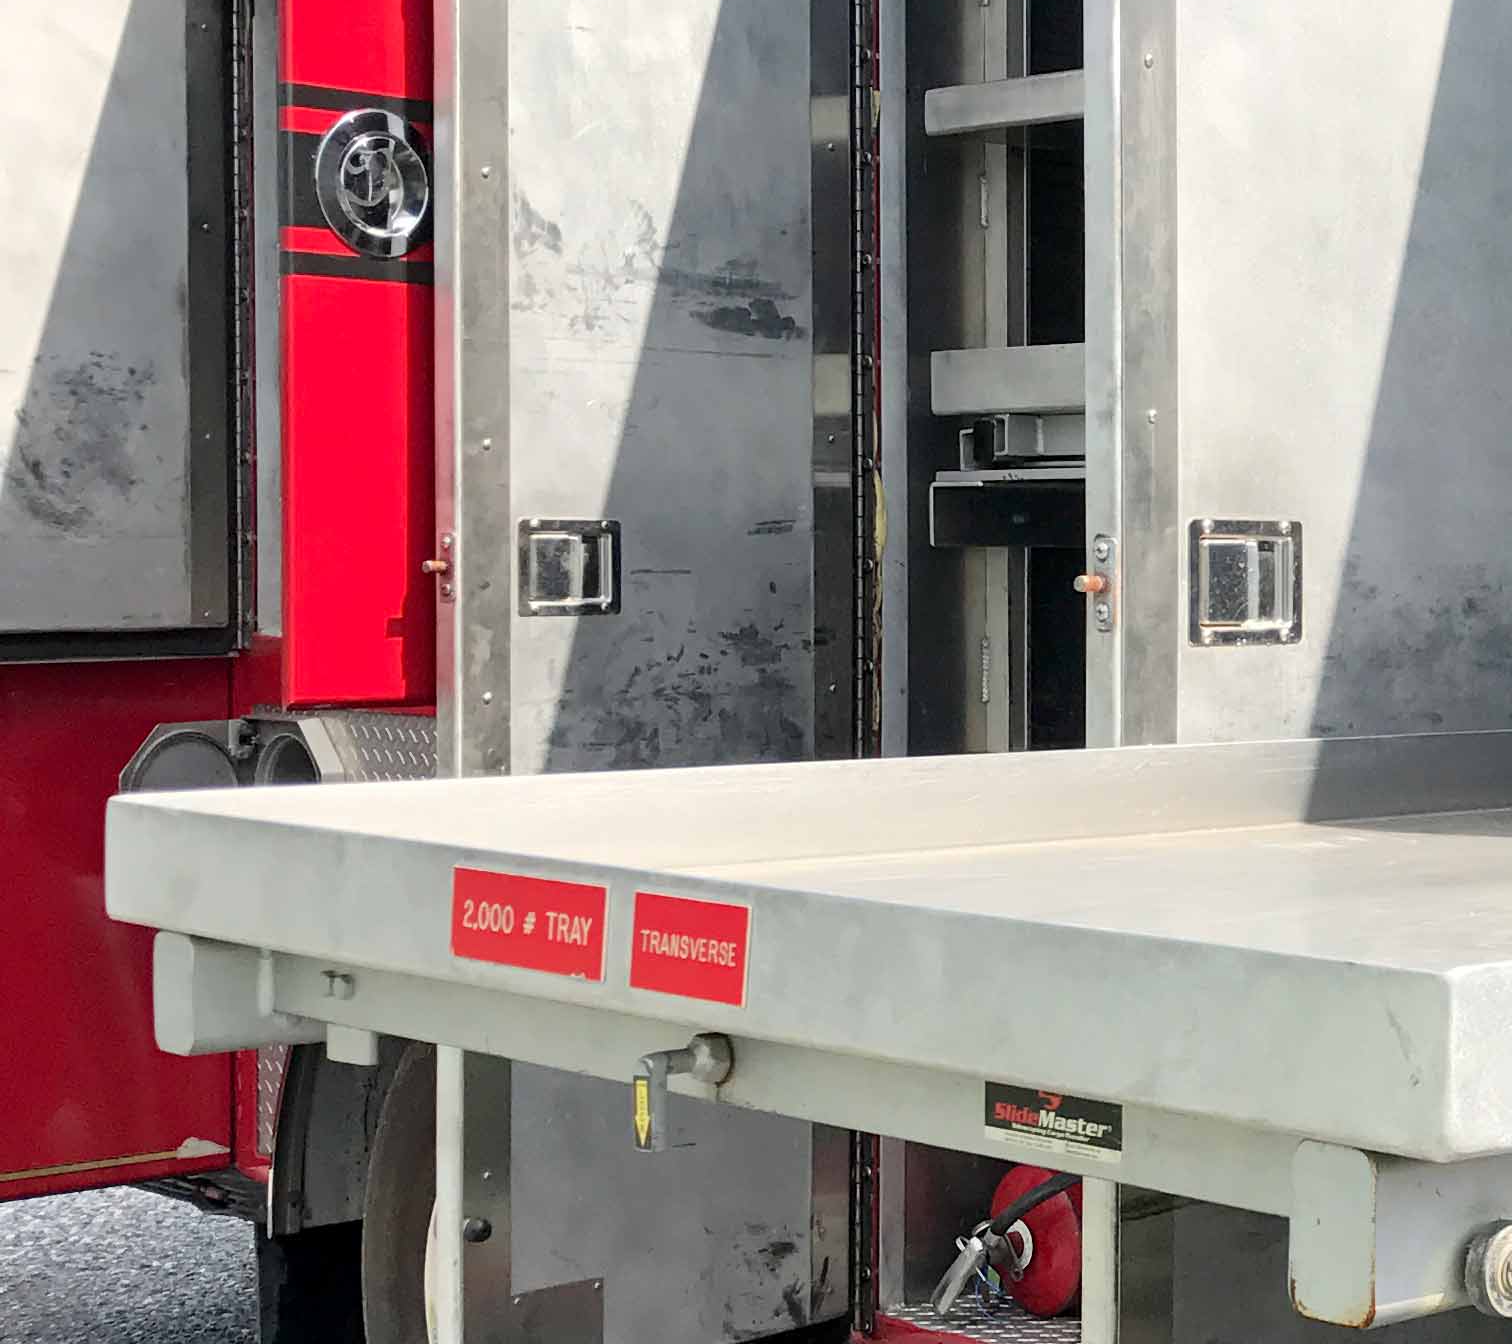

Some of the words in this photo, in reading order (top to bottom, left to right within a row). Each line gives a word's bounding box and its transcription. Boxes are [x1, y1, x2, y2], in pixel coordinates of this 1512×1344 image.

[522, 911, 537, 935] #
[545, 911, 592, 946] TRAY
[639, 929, 737, 967] TRANSVERSE
